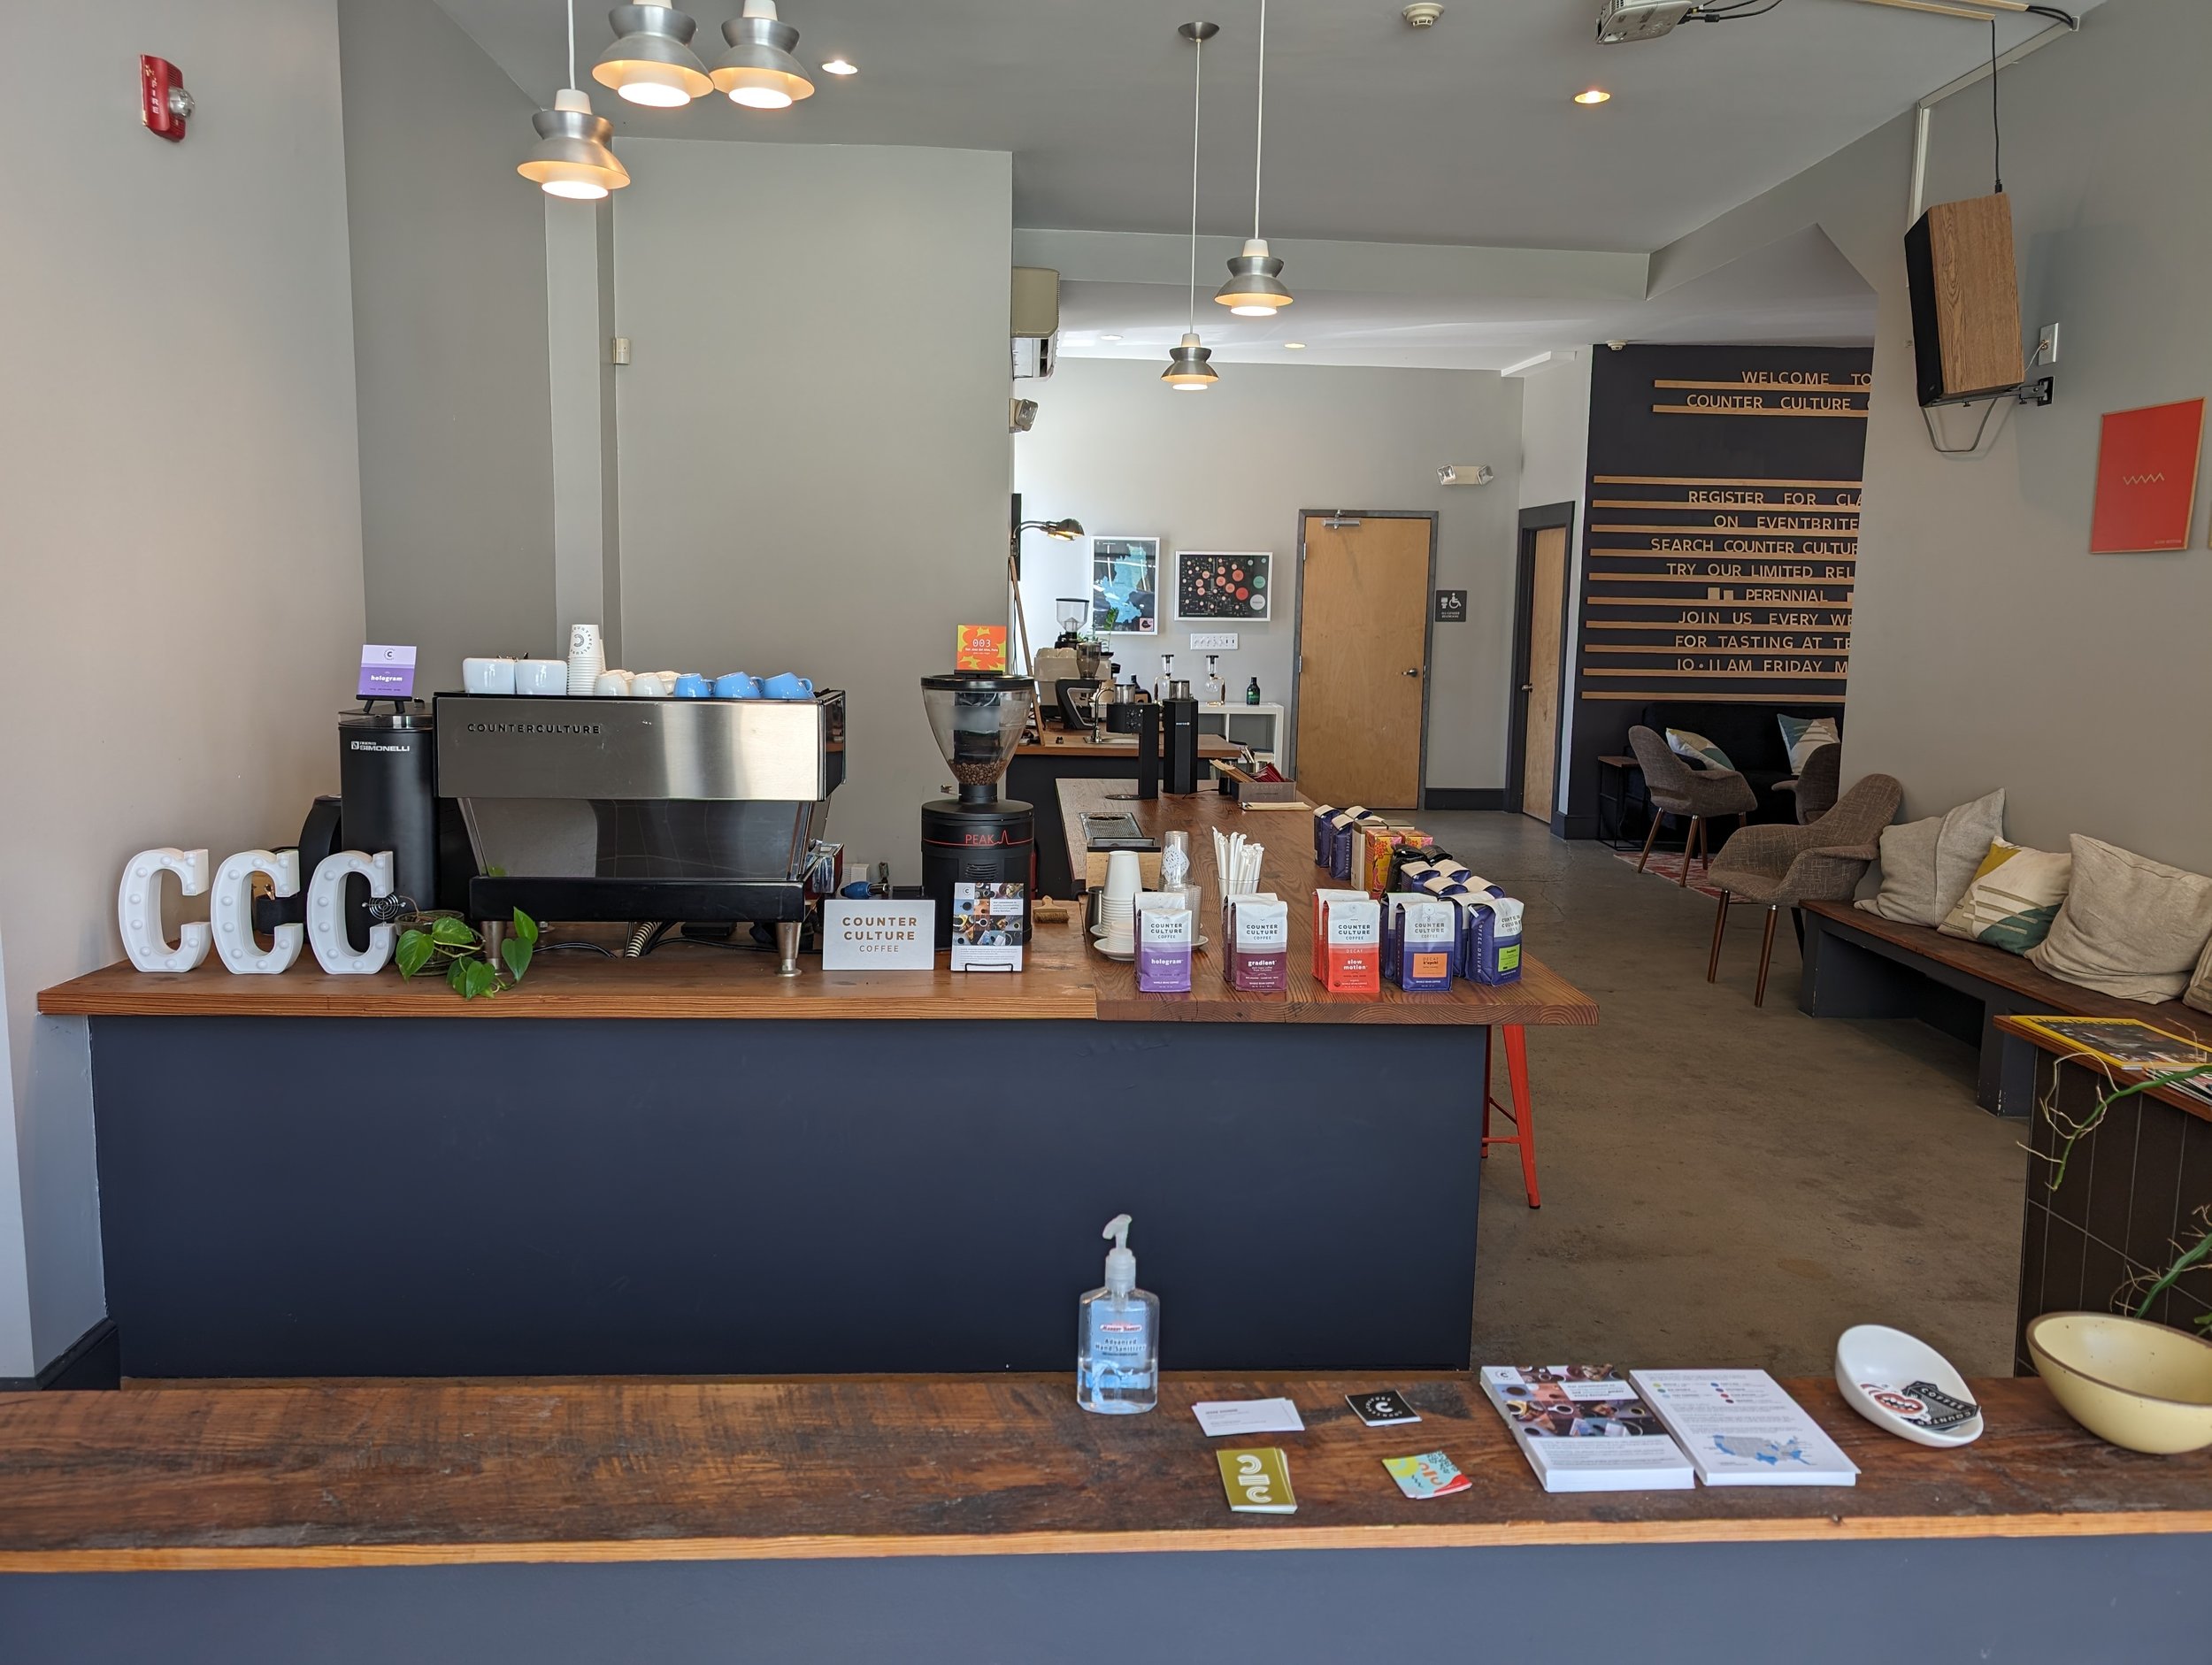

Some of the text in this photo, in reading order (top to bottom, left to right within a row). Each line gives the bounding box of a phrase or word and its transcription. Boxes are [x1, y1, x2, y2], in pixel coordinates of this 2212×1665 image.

[1741, 371, 1871, 386] WELCOME TO
[1686, 394, 1763, 409] COUNTER
[1780, 396, 1851, 410] CULTURE
[1688, 490, 1764, 504] REGISTER
[1784, 493, 1816, 505] FOR
[1714, 515, 1858, 531] ON EVENTBRITE
[1650, 538, 1714, 552] SEARCH
[1724, 540, 1795, 554] COUNTER
[1666, 563, 1855, 579] TRY OUR LIMITED REL
[1746, 588, 1828, 602] PERENNIAL
[1678, 611, 1720, 625] JOIN
[1732, 612, 1753, 625] US
[1769, 613, 1819, 626] EVERY
[972, 638, 992, 648] 003
[1675, 635, 1708, 648] FOR
[1717, 635, 1793, 649] TASTING
[1801, 637, 1823, 649] AT
[1763, 660, 1823, 673] FRIDAY
[370, 674, 403, 683] hologram
[965, 833, 995, 845] PEAK
[841, 917, 918, 927] COUNTER
[843, 931, 916, 941] CULTURE
[1920, 1386, 1965, 1410] COFFEE
